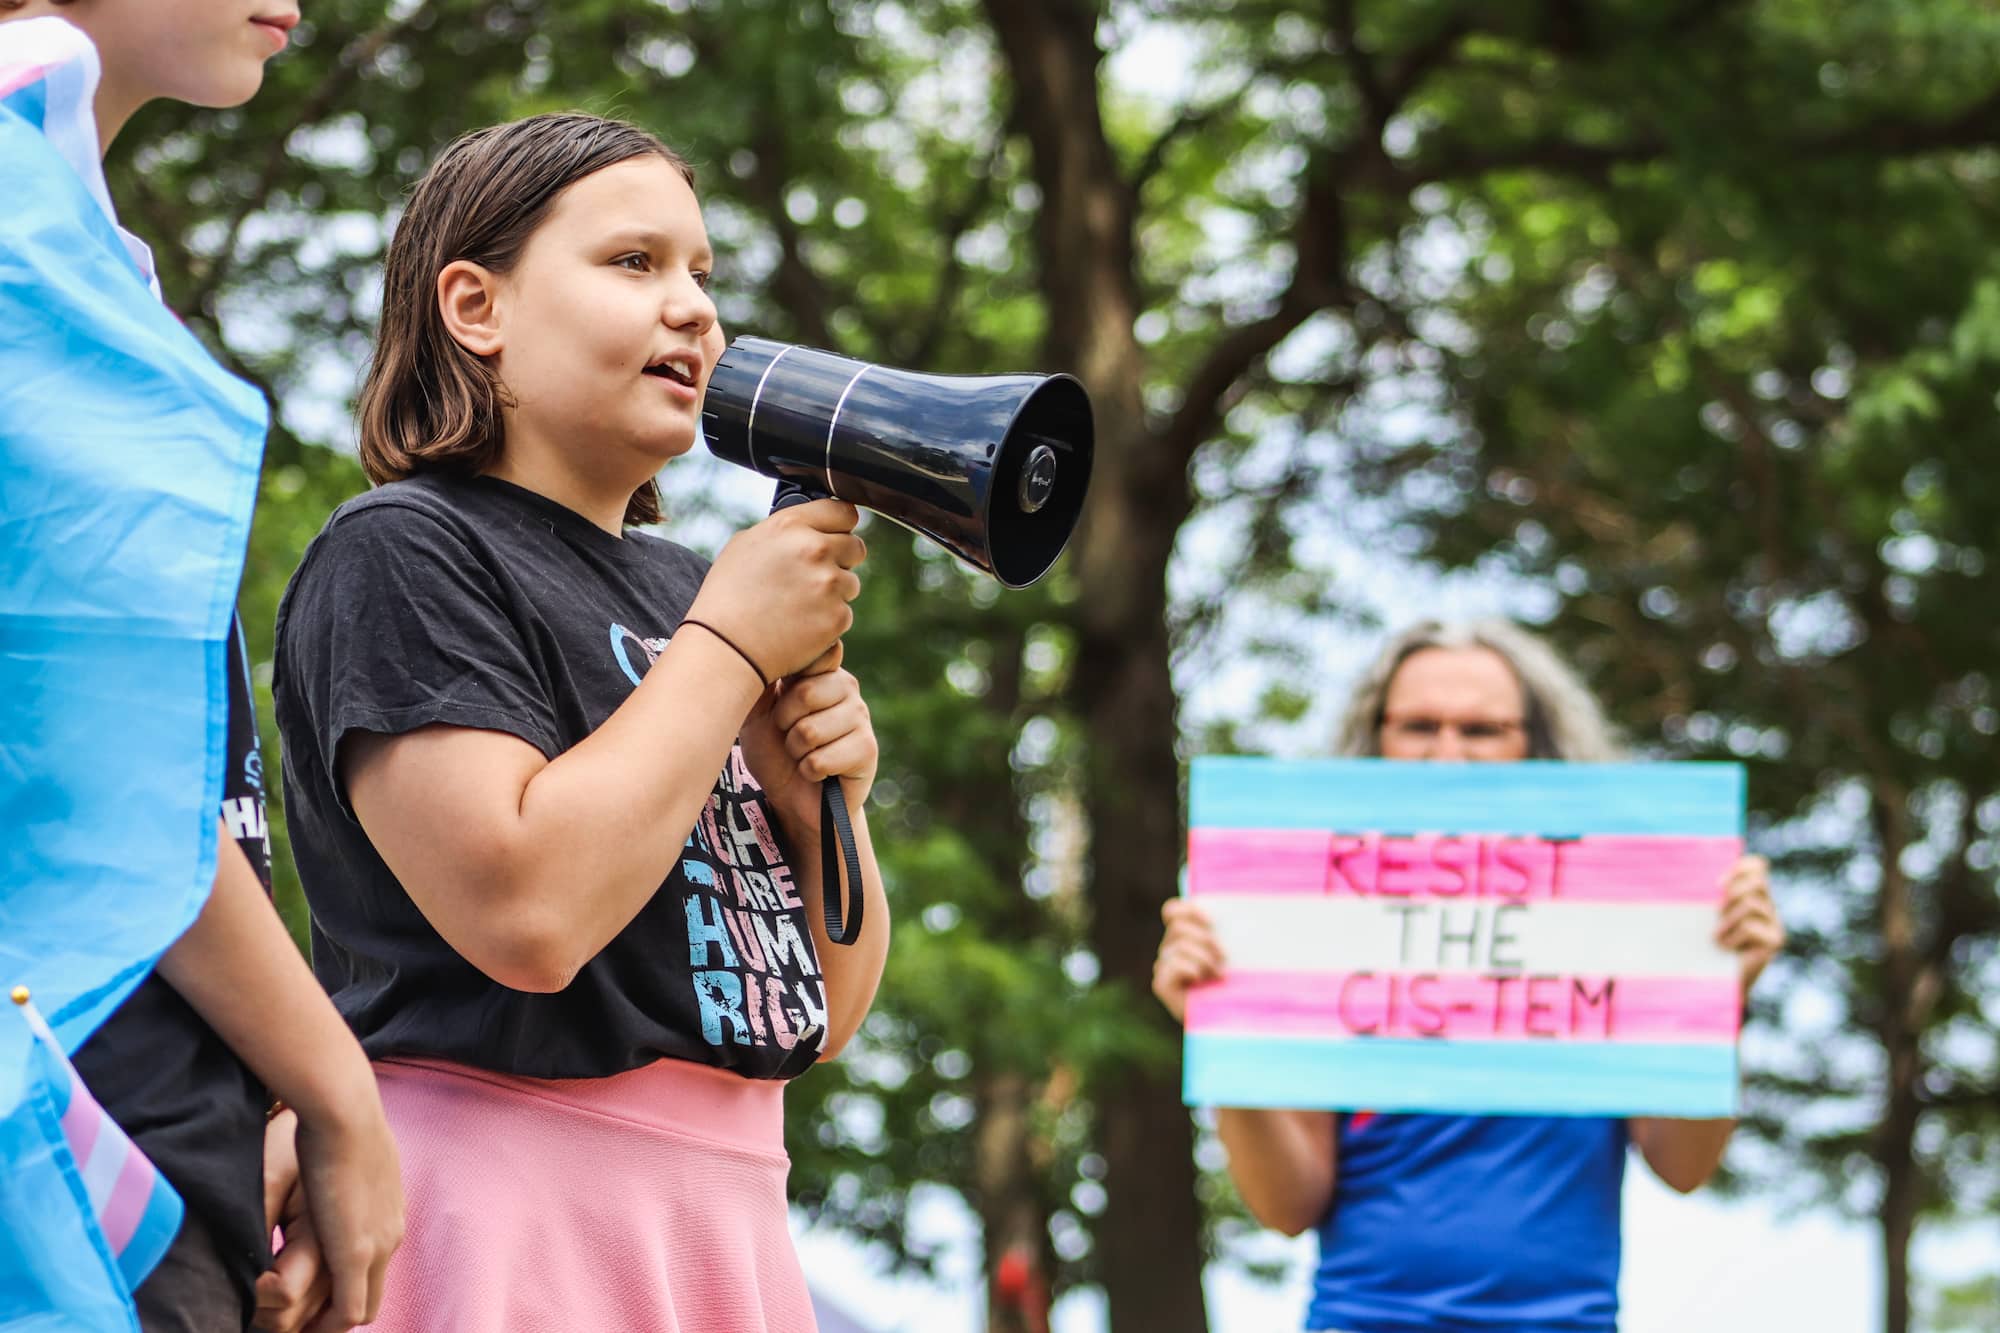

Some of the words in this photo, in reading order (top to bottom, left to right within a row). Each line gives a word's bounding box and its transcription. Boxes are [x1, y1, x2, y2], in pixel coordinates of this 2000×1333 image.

[731, 865, 804, 911] ARE
[1324, 833, 1582, 897] RESIST
[685, 893, 822, 977] HUM
[1384, 901, 1529, 968] THE
[1338, 970, 1616, 1037] CIS-TEM
